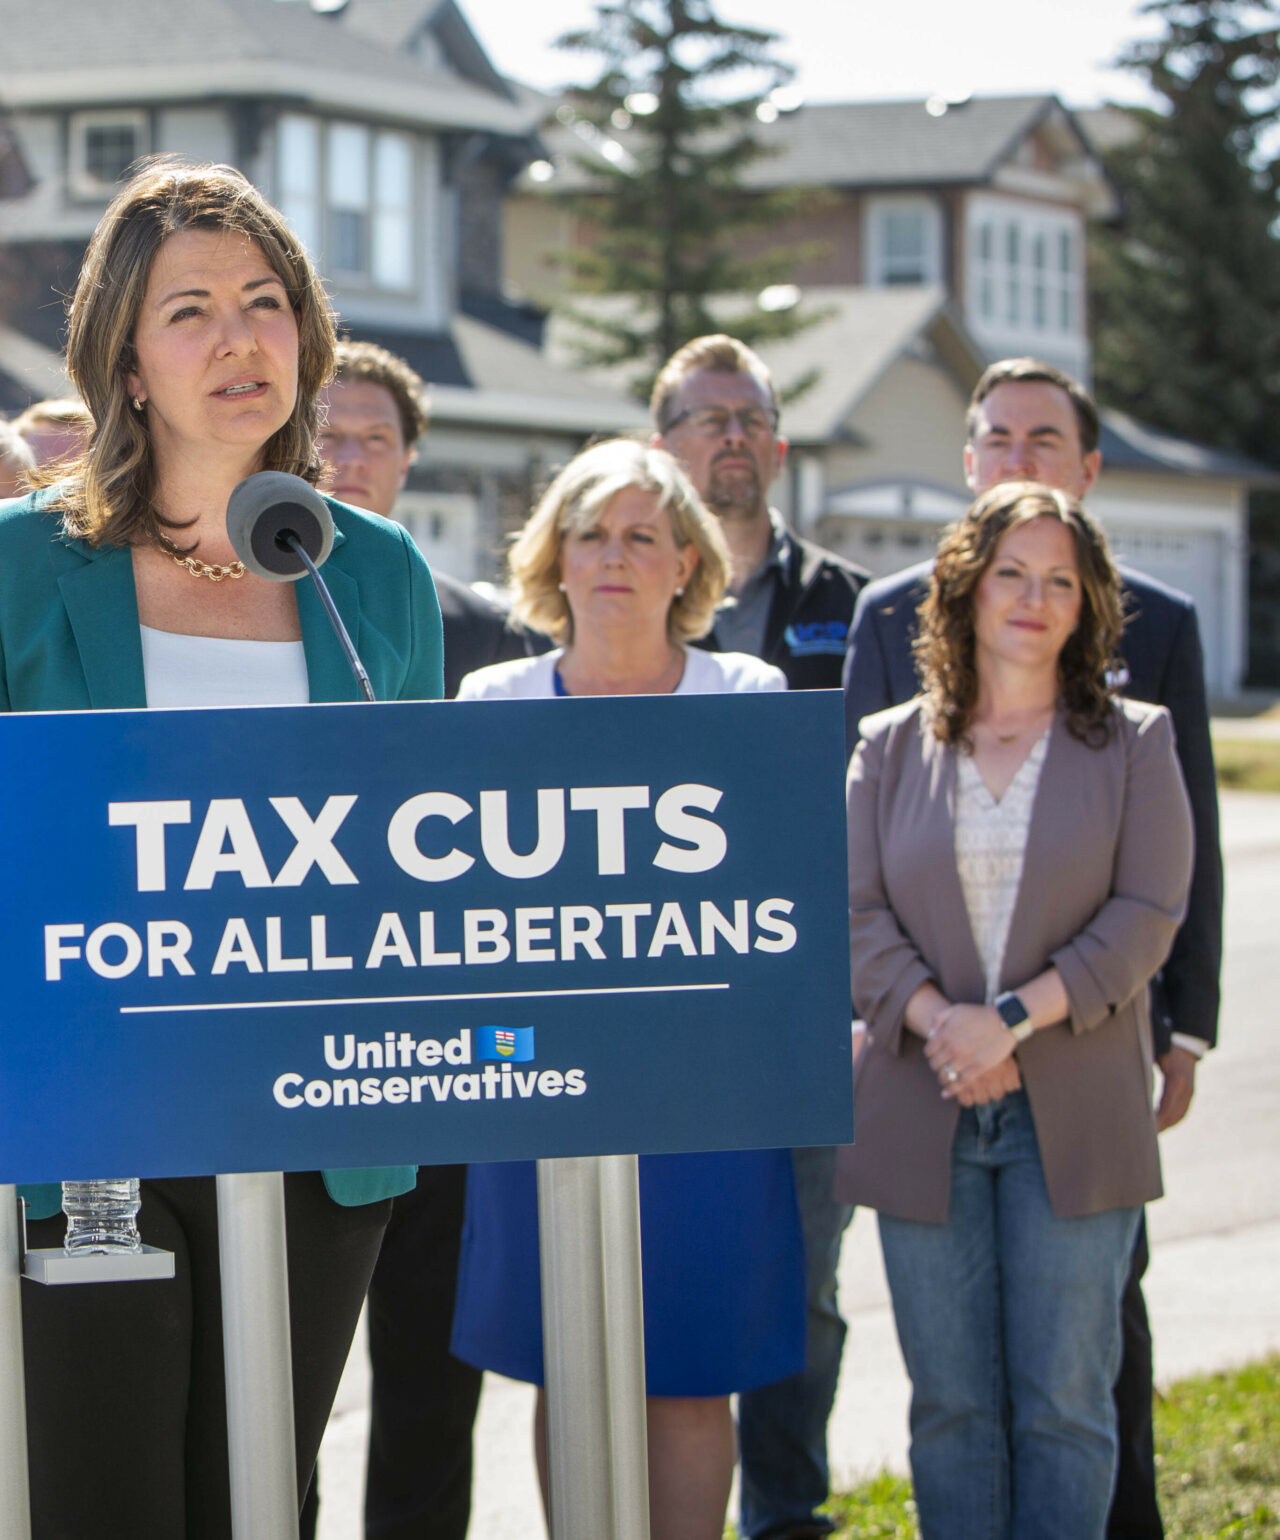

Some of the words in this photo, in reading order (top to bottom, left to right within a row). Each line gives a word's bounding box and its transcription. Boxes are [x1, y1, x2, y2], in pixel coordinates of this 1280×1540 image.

[108, 794, 360, 892] TAX
[388, 783, 727, 882] CUTS
[44, 920, 196, 980] FOR
[211, 914, 354, 974] ALL
[365, 898, 797, 969] ALBERTANS
[323, 1028, 472, 1070] United
[272, 1062, 587, 1109] Conservatives
